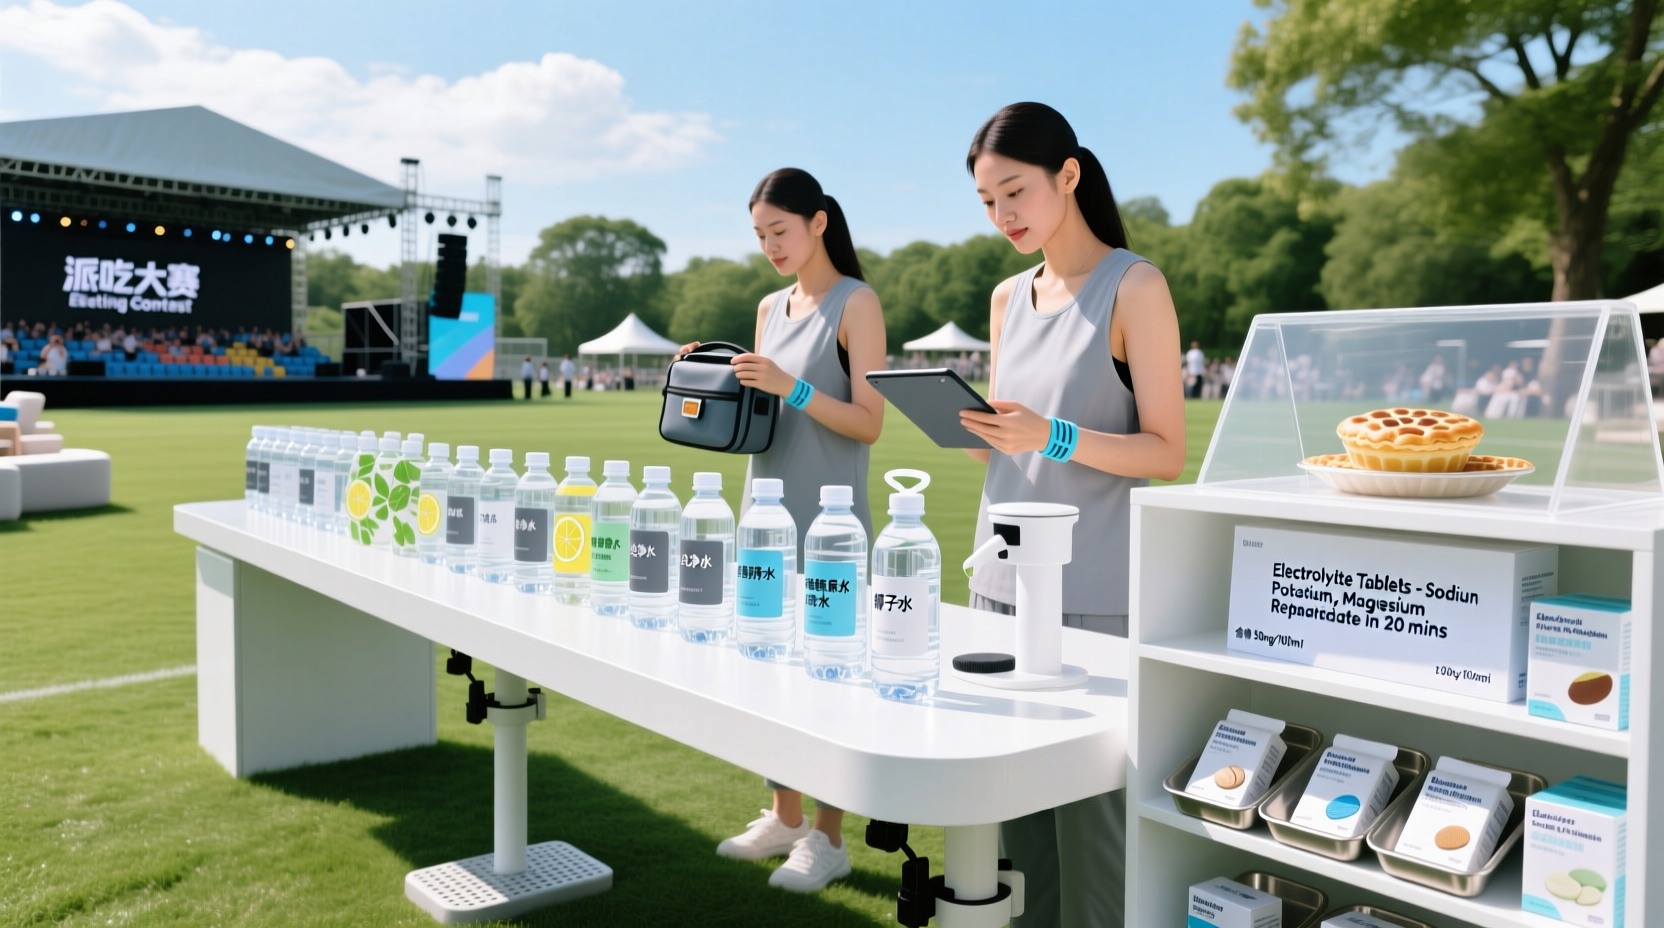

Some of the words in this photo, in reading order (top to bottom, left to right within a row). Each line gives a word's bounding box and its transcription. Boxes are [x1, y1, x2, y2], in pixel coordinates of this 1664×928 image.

[62, 255, 200, 299] 派吃大赛
[1425, 581, 1479, 606] Sodiun
[1383, 615, 1405, 632] 20
[1407, 619, 1448, 639] mins
